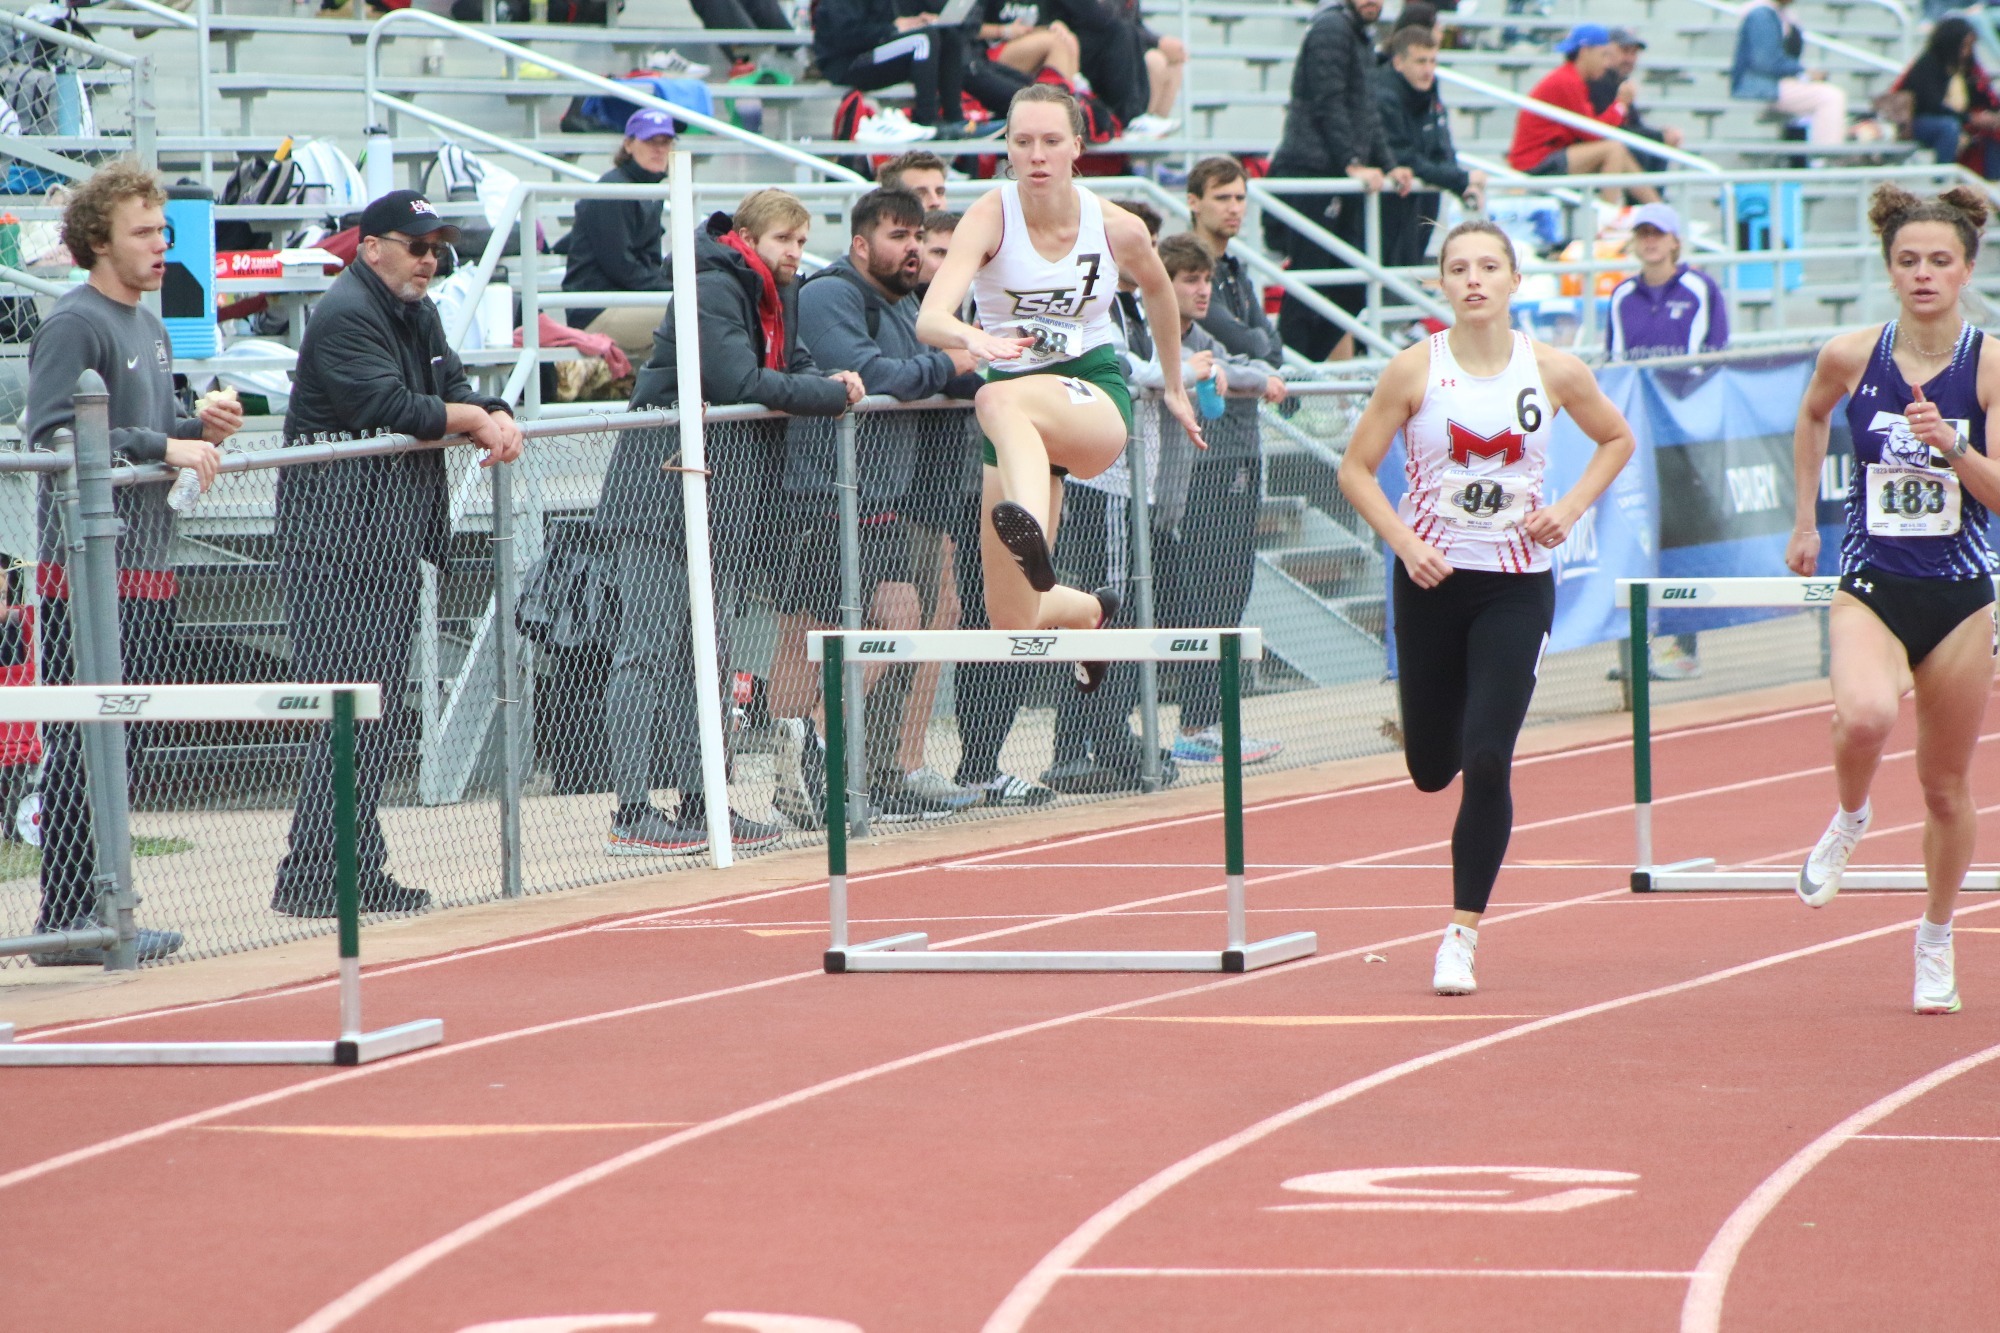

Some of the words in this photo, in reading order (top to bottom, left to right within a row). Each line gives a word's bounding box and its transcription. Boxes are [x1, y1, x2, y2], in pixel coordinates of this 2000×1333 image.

[1076, 253, 1101, 296] 7
[1517, 387, 1541, 432] 6
[1447, 418, 1526, 469] M
[1463, 483, 1503, 513] 94
[1726, 464, 1780, 513] DRURY
[1883, 481, 1945, 514] 183
[1662, 588, 1697, 599] GILL
[858, 641, 896, 653] GILL
[1008, 637, 1057, 656] S&T
[1170, 639, 1208, 651] GILL
[96, 694, 151, 714] S&T
[277, 696, 320, 710] GILL
